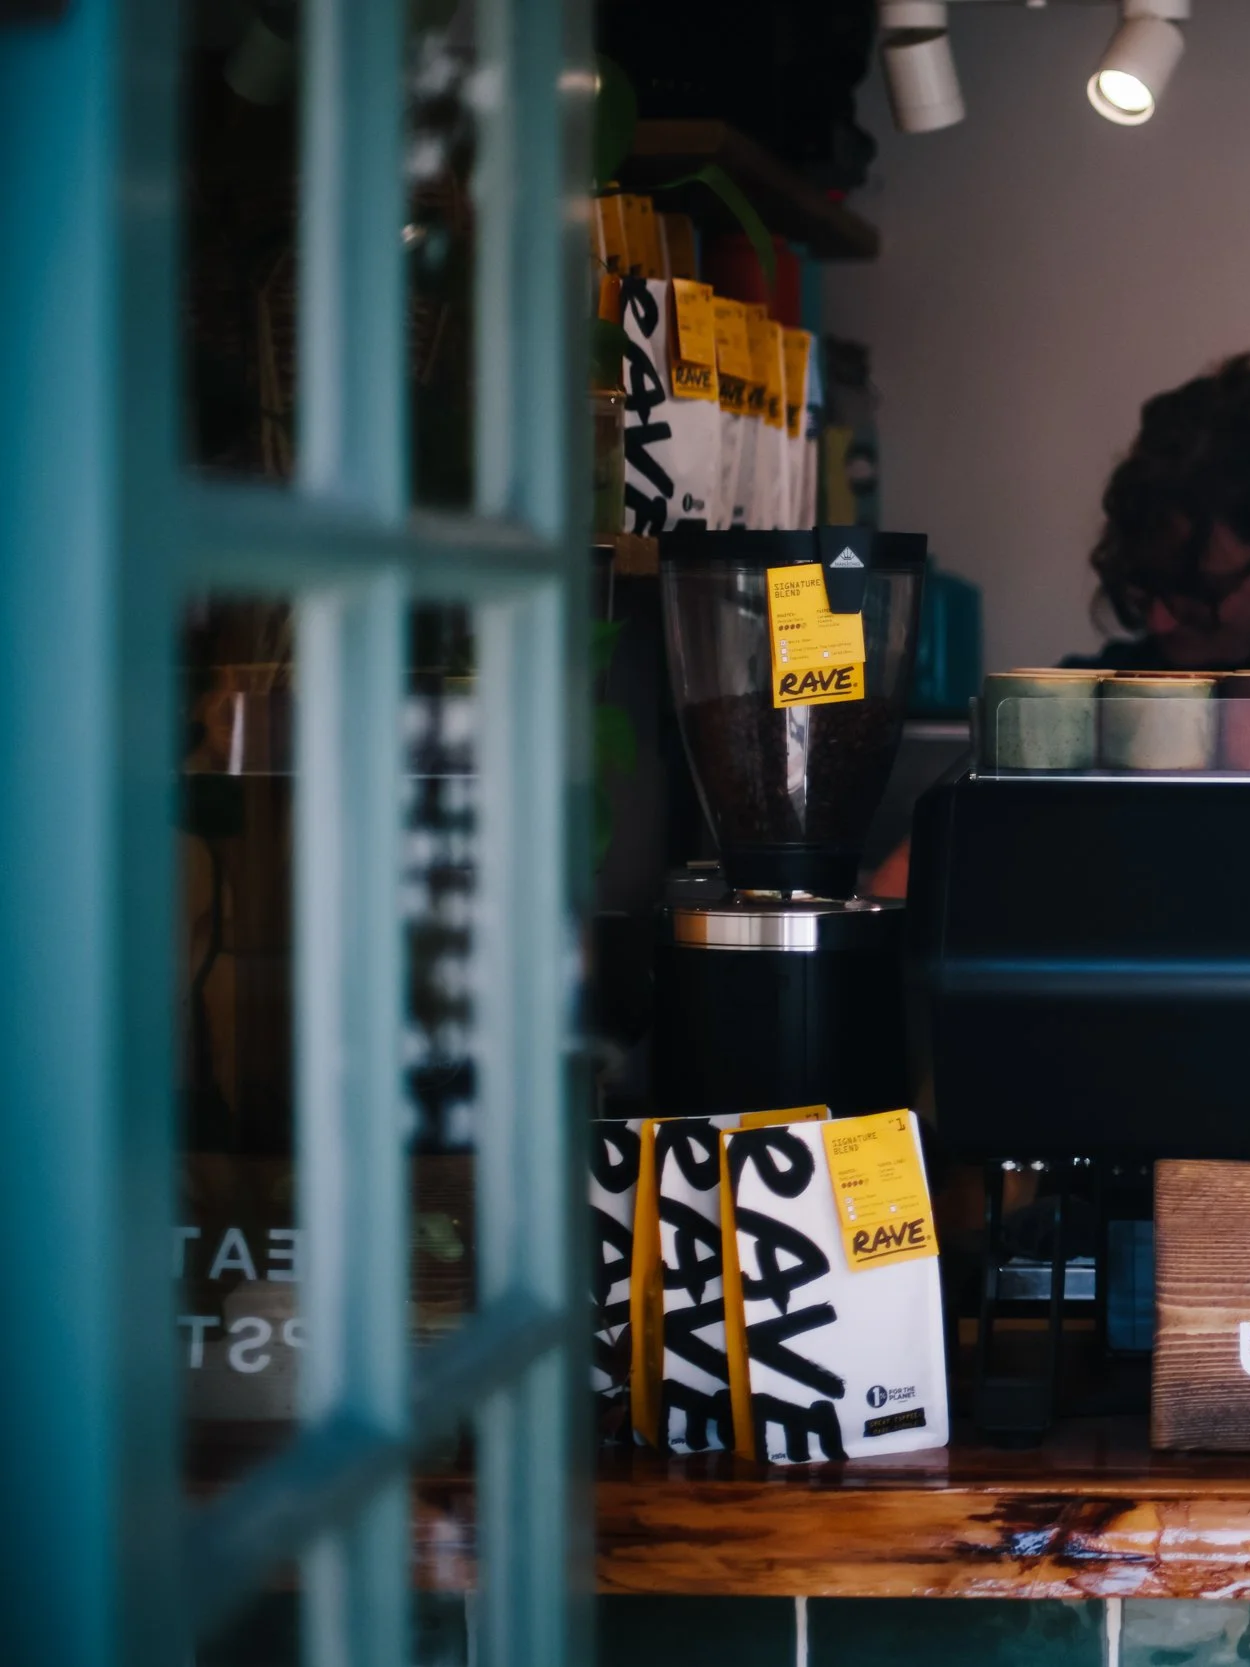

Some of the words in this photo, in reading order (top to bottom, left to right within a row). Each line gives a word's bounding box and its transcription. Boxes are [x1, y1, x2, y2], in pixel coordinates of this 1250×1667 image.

[774, 579, 820, 591] SIGNATURE
[775, 589, 801, 598] BLEND
[832, 1132, 878, 1147] SIGNATURE
[833, 1145, 859, 1155] BLEND
[726, 1126, 849, 1463] RAVE
